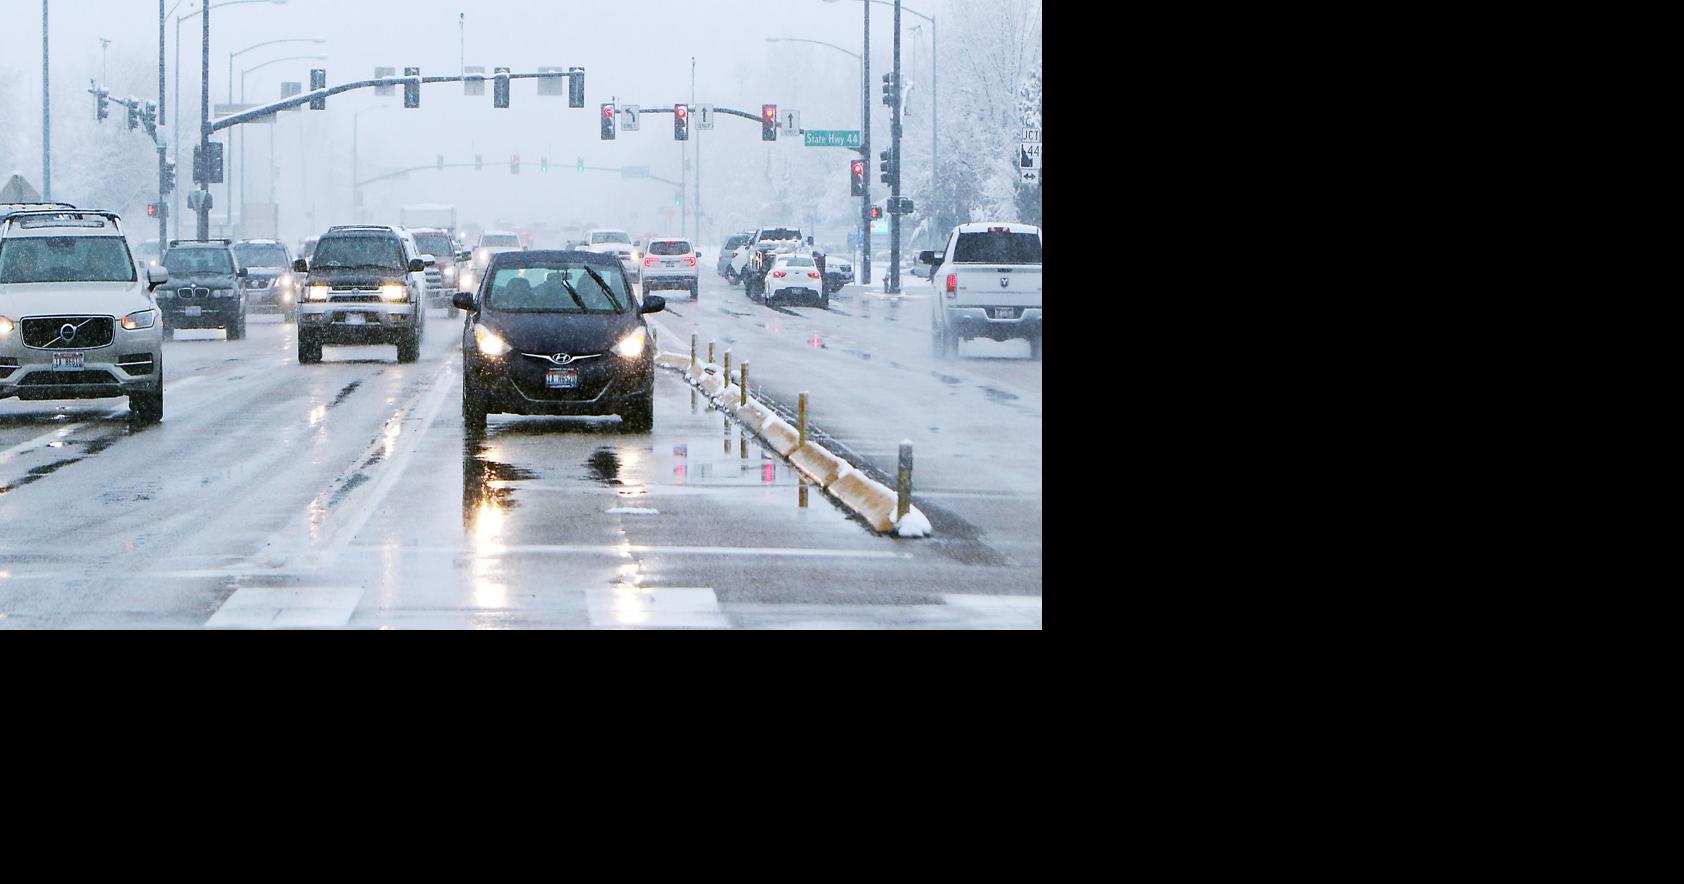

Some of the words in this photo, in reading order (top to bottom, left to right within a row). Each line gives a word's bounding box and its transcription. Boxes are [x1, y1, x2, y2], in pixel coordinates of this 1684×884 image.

[806, 133, 826, 144] State
[828, 133, 845, 146] Hwy
[847, 133, 858, 144] 44
[1023, 130, 1038, 140] JCT
[1027, 145, 1039, 156] 44
